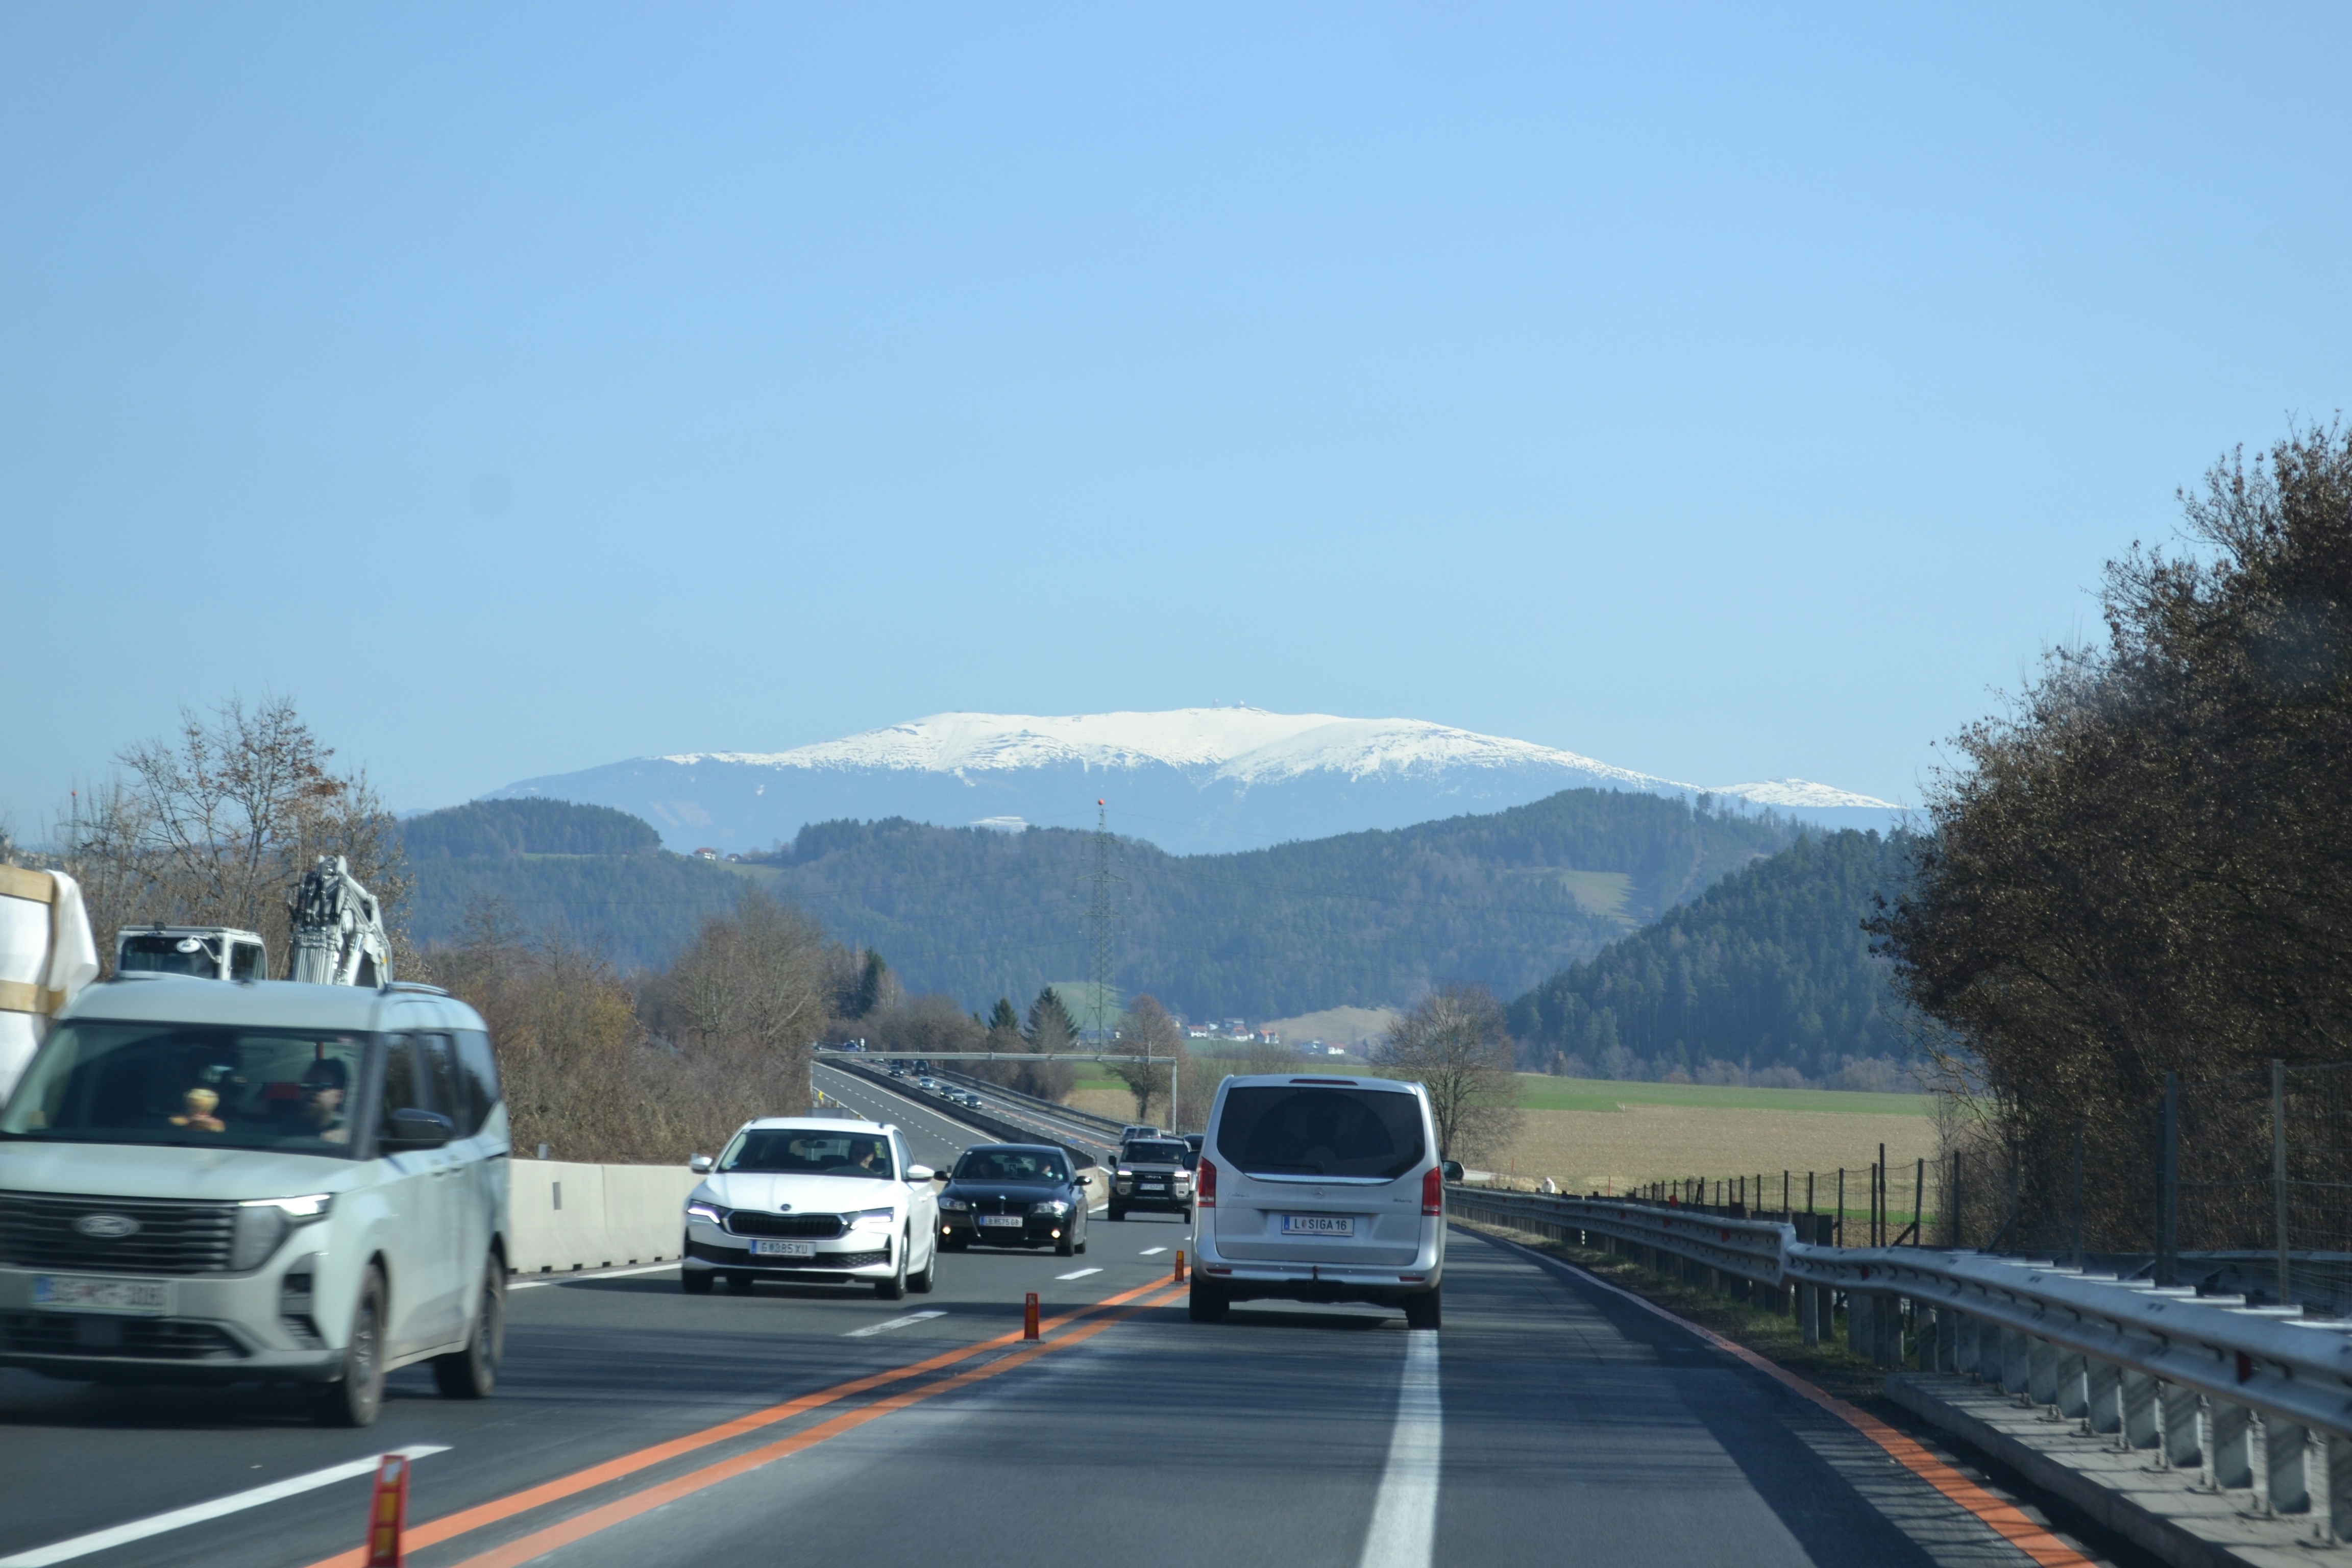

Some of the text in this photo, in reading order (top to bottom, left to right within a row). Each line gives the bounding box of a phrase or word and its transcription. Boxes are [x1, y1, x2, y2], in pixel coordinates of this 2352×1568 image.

[1294, 1219, 1347, 1231] L SIGA 16
[762, 1242, 807, 1254] G 385 XU
